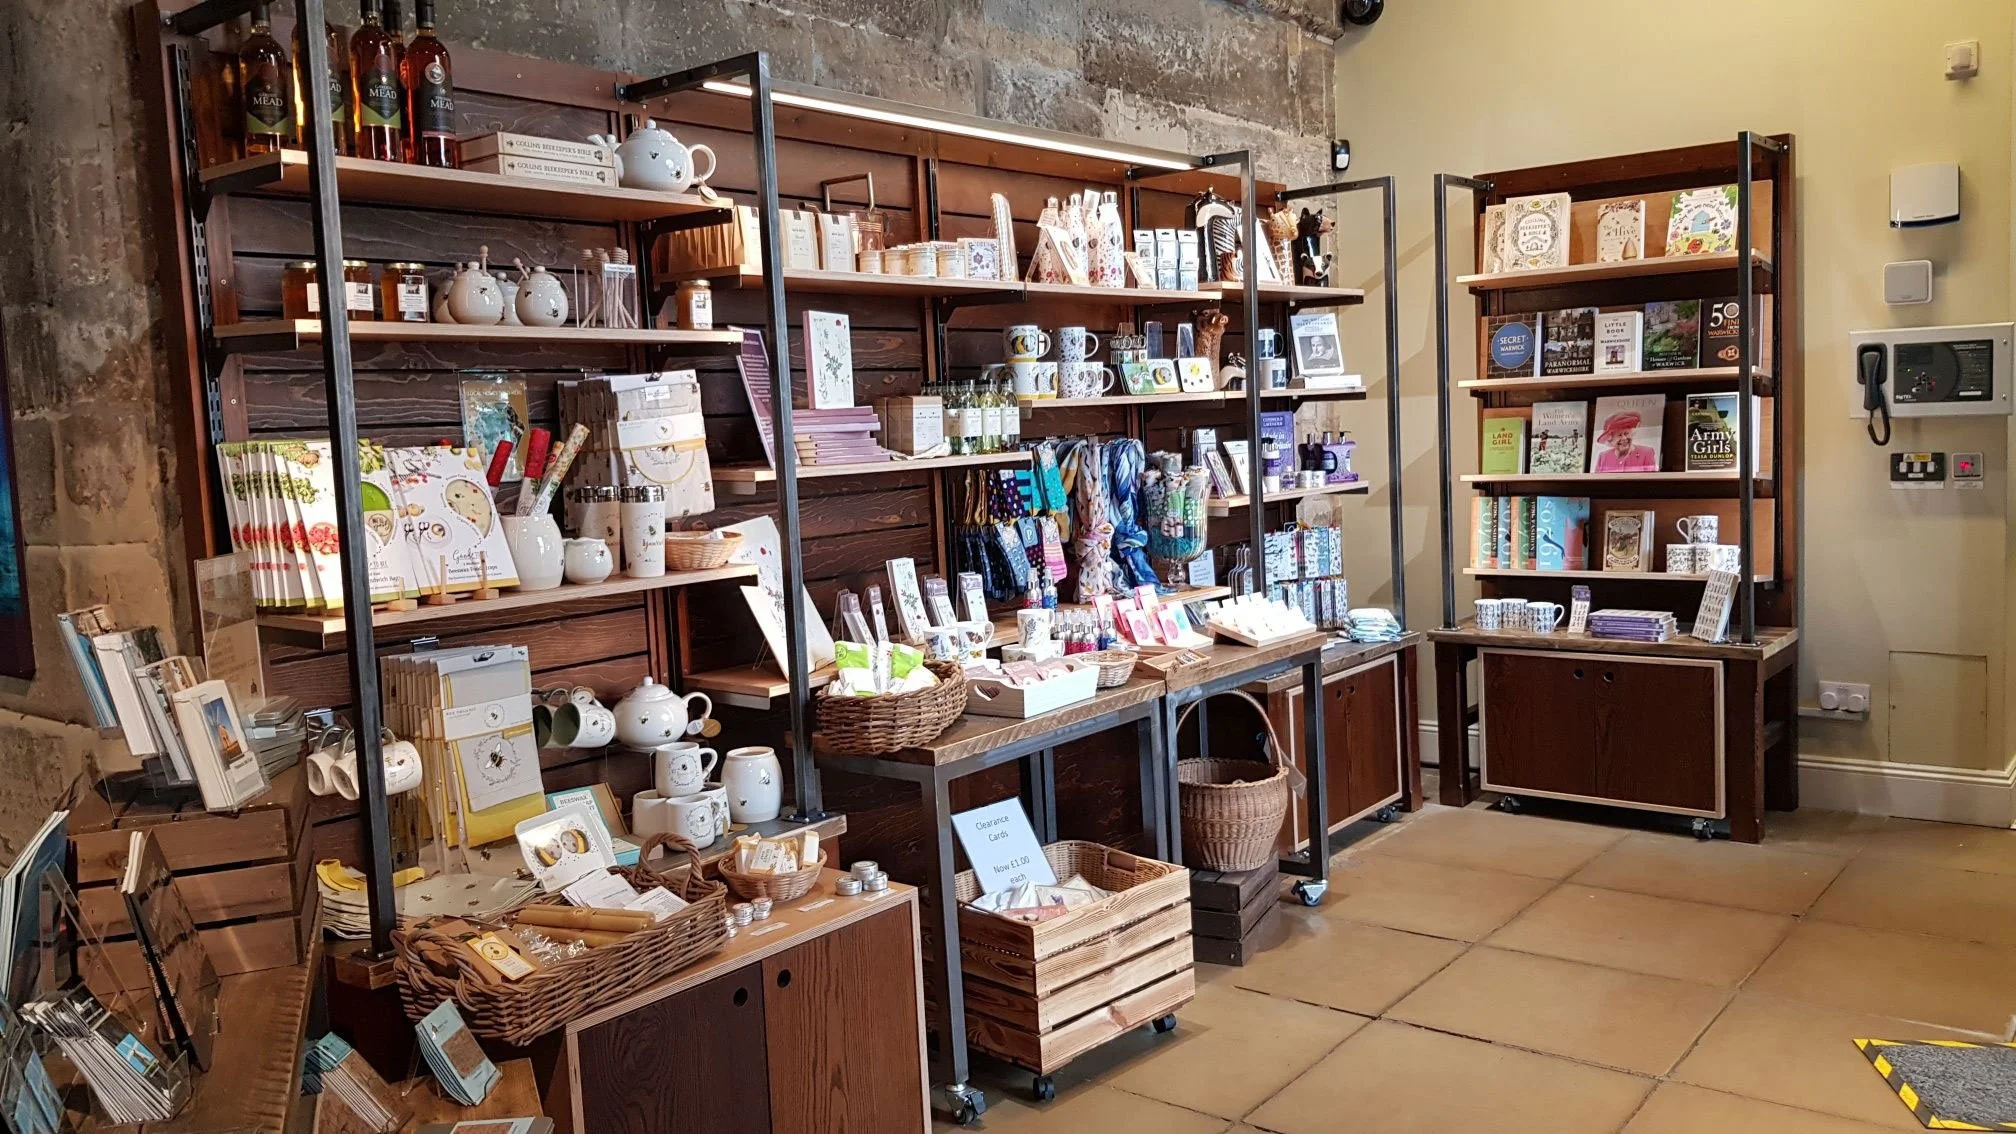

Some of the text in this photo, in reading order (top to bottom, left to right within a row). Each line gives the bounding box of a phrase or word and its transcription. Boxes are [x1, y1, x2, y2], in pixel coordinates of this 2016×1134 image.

[369, 88, 397, 100] MEAD
[253, 96, 283, 107] MEAD
[430, 99, 454, 111] MEAD
[515, 140, 541, 150] COLLINS
[542, 144, 576, 154] BEEKEEPER'S
[578, 148, 592, 156] BIBLE
[517, 162, 543, 171] COLLINS
[544, 165, 579, 175] BEEKEEPER'S
[1611, 225, 1636, 237] Hive
[1710, 302, 1740, 327] 50
[1499, 334, 1526, 345] SECRET
[1500, 344, 1525, 352] WARWICK
[1544, 358, 1592, 368] PARANORMAL
[1546, 365, 1590, 374] WARWICKSHIRE
[1690, 428, 1734, 443] Army
[1492, 438, 1513, 446] GIRL
[1693, 440, 1731, 454] Girls
[1537, 500, 1556, 567] 1920s
[560, 795, 588, 805] BEESWAX
[976, 816, 1009, 830] Clearance
[988, 830, 1009, 842] Cards
[993, 855, 1030, 874] Now £1.00
[1010, 872, 1027, 884] each
